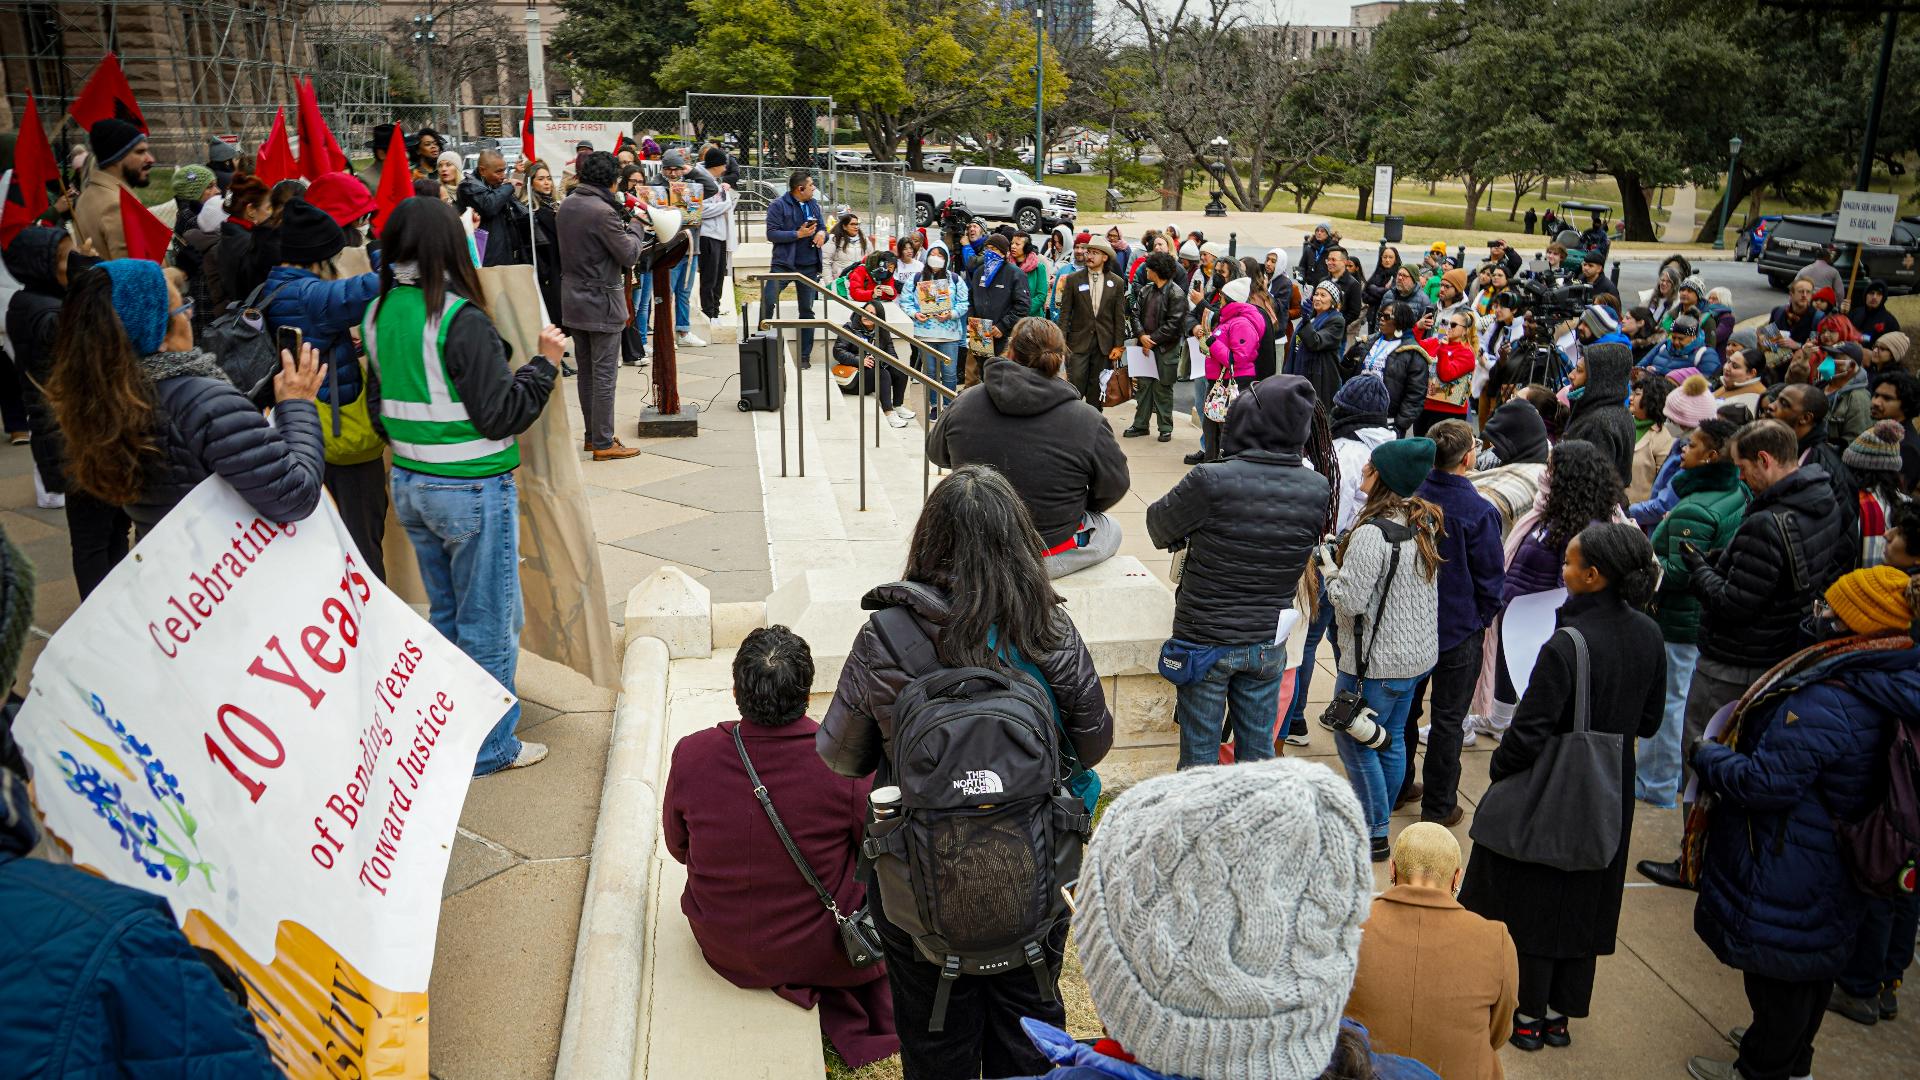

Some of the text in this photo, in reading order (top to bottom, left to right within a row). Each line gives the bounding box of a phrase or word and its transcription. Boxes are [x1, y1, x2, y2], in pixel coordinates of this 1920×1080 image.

[546, 123, 577, 132] SAFETY
[204, 552, 371, 804] 10 Years
[311, 638, 423, 870] of Bending Texas
[965, 770, 986, 780] THE
[953, 777, 986, 789] NORTH
[359, 690, 454, 897] Toward Justice
[962, 785, 987, 796] FACE
